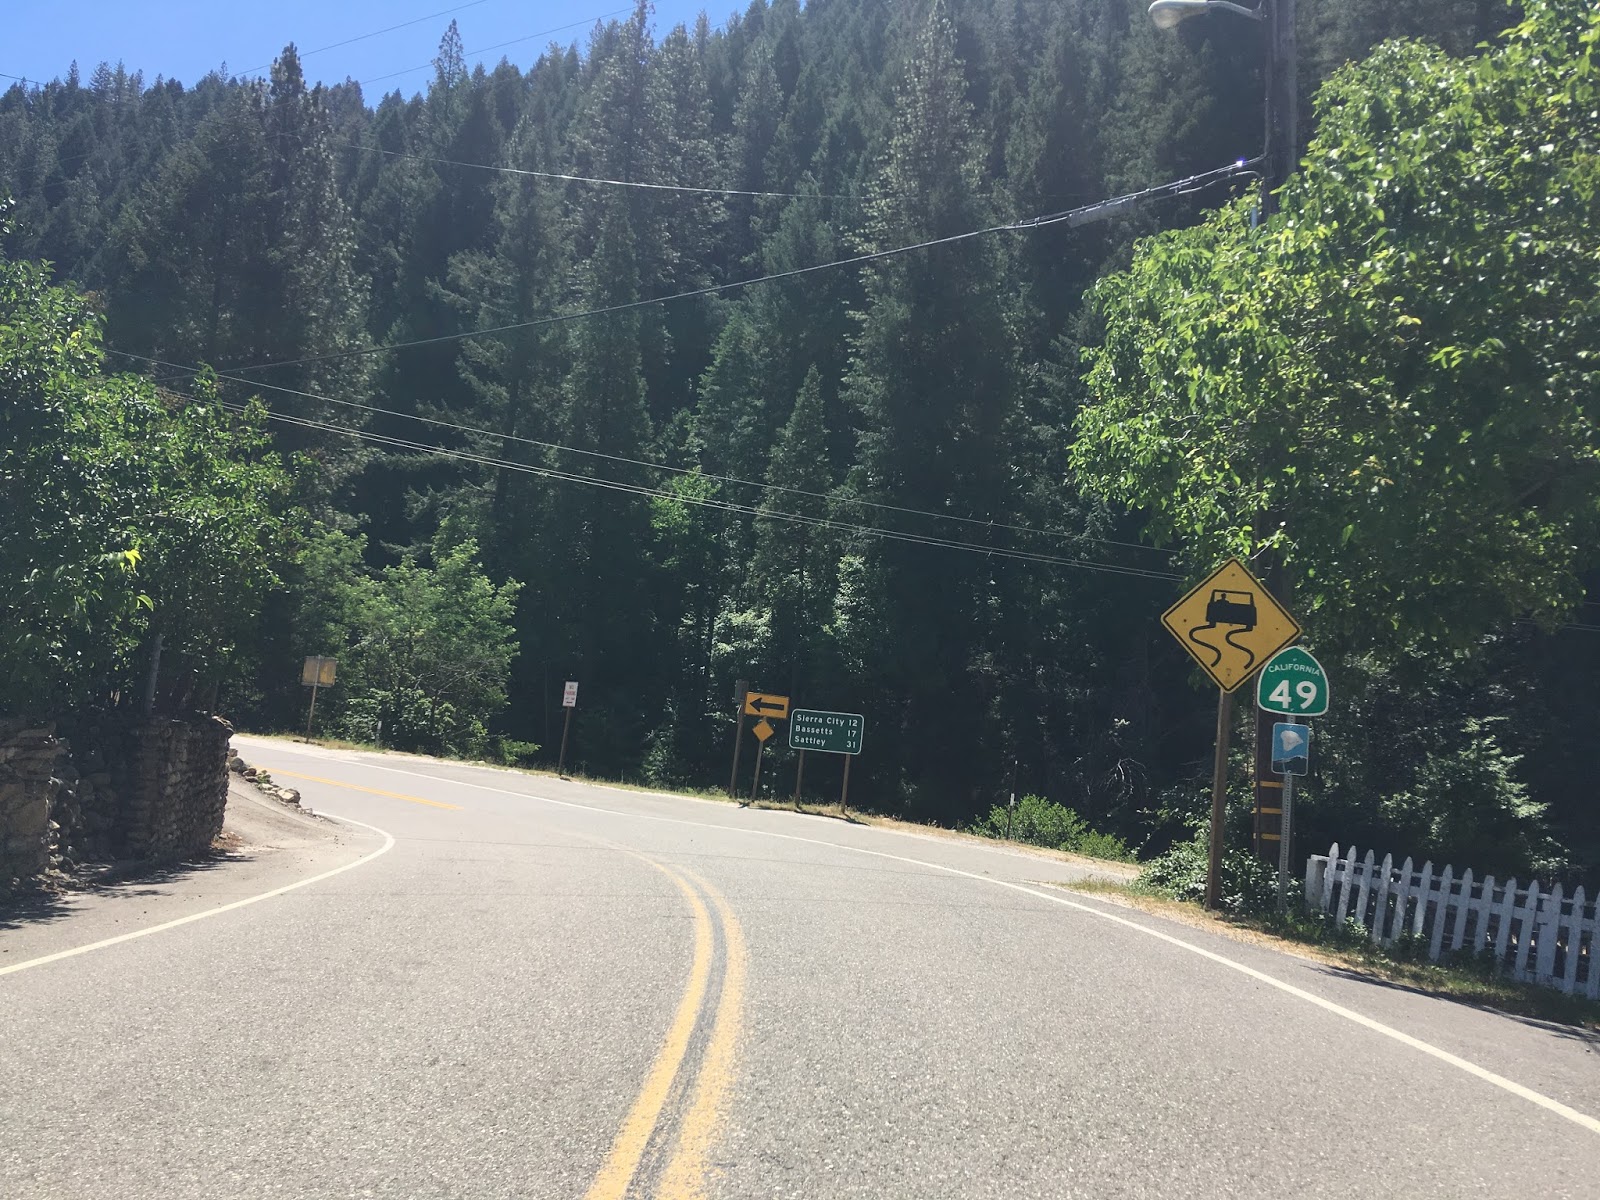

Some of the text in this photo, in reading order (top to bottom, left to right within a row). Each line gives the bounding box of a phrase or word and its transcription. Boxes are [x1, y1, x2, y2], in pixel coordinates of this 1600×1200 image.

[1268, 663, 1320, 676] CALIFORNIA
[1268, 679, 1317, 710] 49
[796, 714, 858, 727] Sierra City 12
[795, 725, 857, 738] Bassetts 17
[794, 735, 856, 749] Sattley 31
